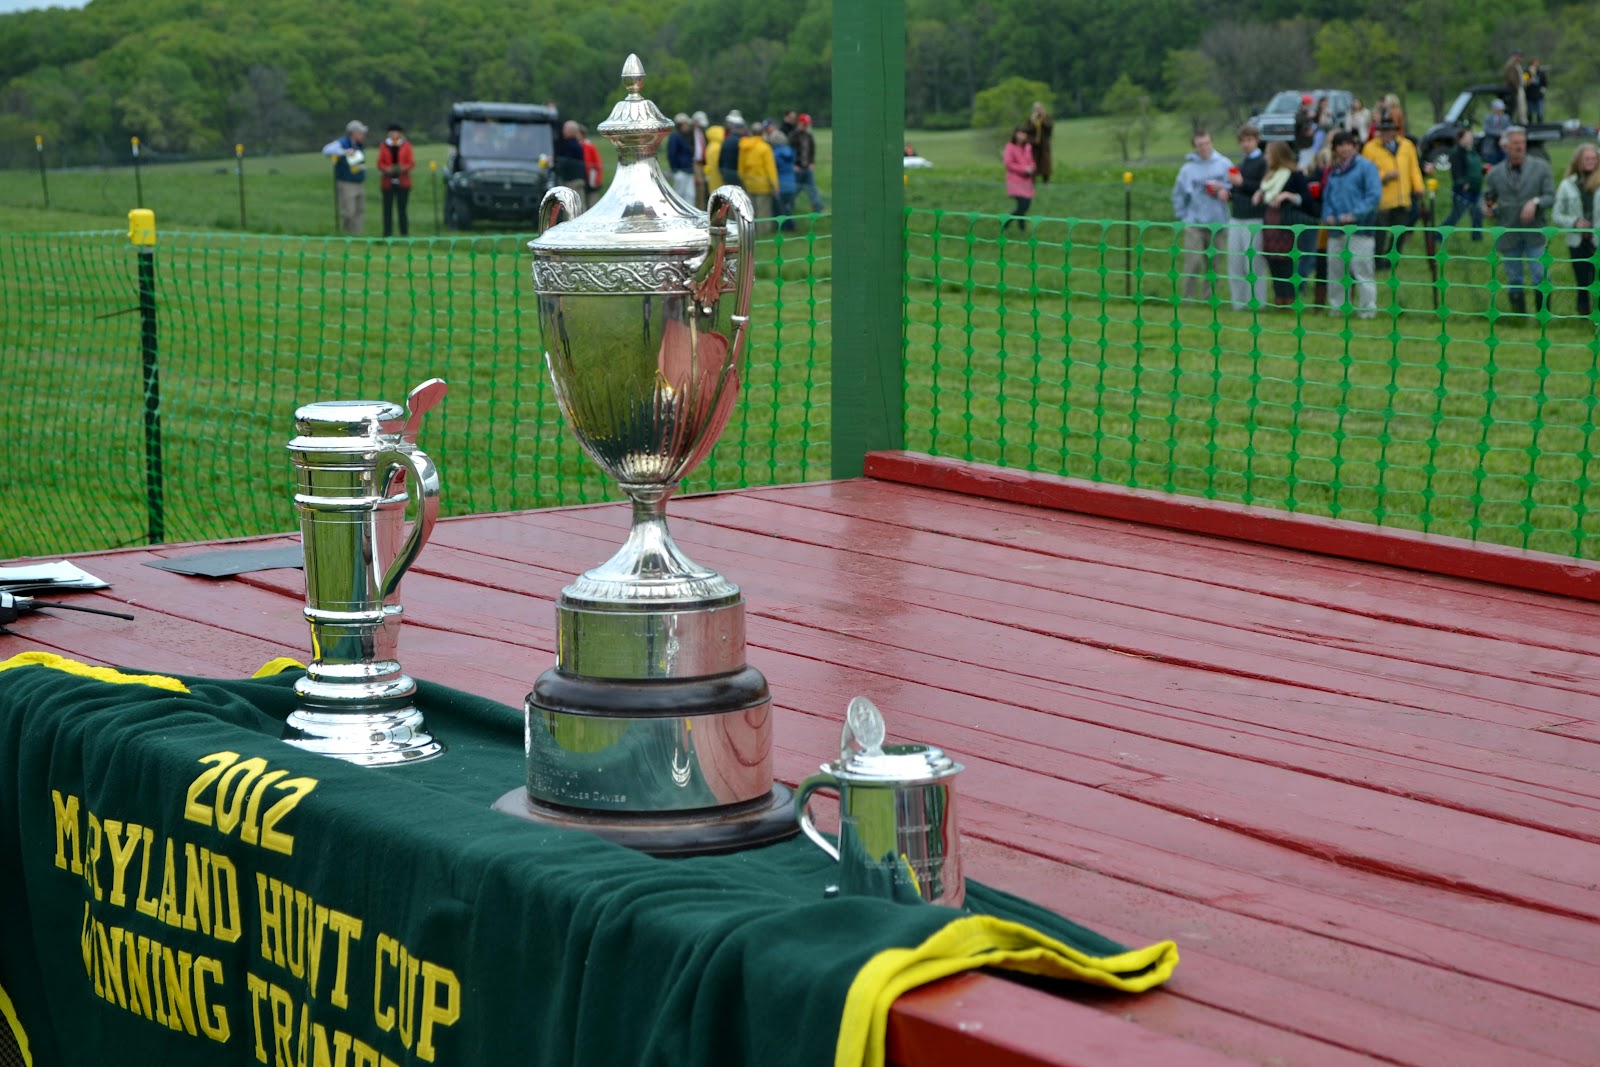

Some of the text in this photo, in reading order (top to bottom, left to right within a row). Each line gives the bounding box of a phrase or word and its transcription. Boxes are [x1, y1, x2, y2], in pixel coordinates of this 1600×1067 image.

[184, 751, 318, 856] 2012
[51, 789, 242, 943] MRYLAND
[373, 932, 461, 1063] CUP
